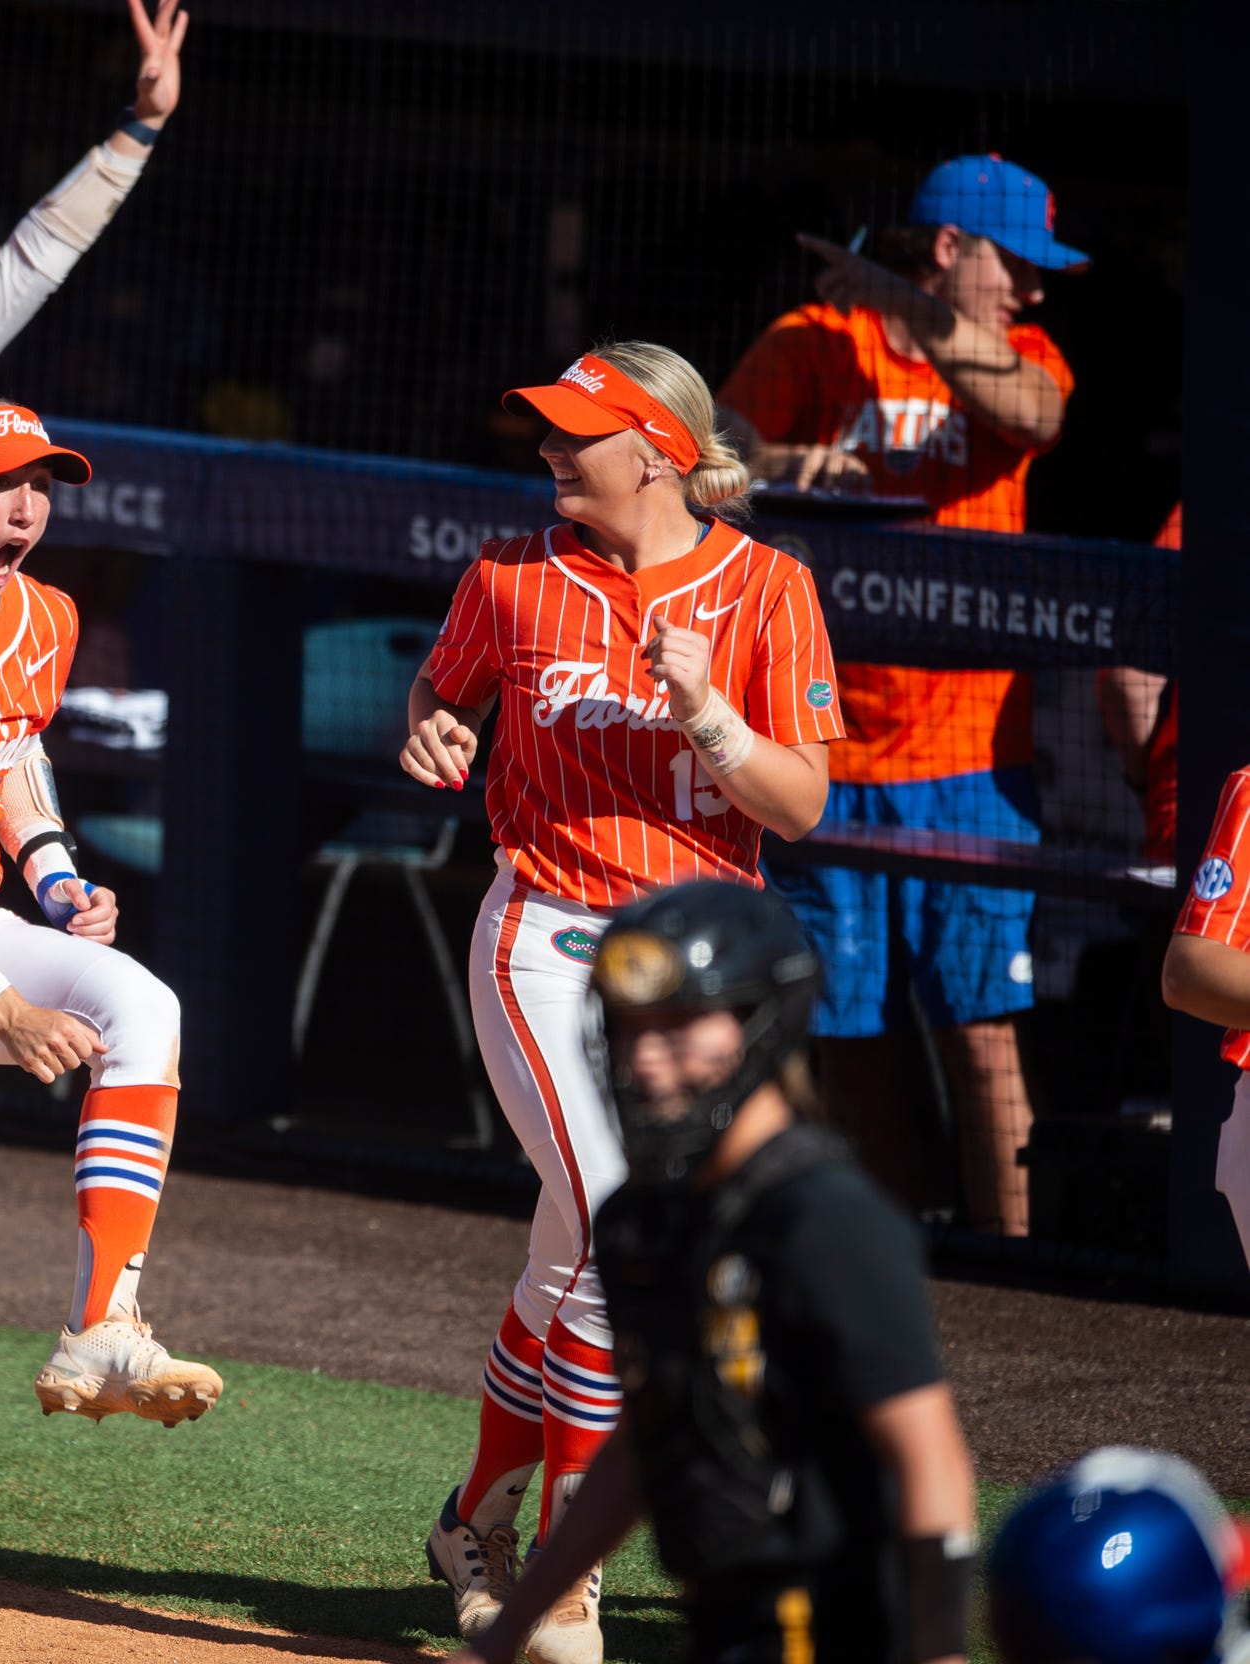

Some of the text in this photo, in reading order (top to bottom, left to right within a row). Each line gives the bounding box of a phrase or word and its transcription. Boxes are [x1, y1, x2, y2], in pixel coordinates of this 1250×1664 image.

[830, 567, 1116, 649] CONFERENCE
[668, 749, 737, 823] 15
[1193, 856, 1234, 901] SEC
